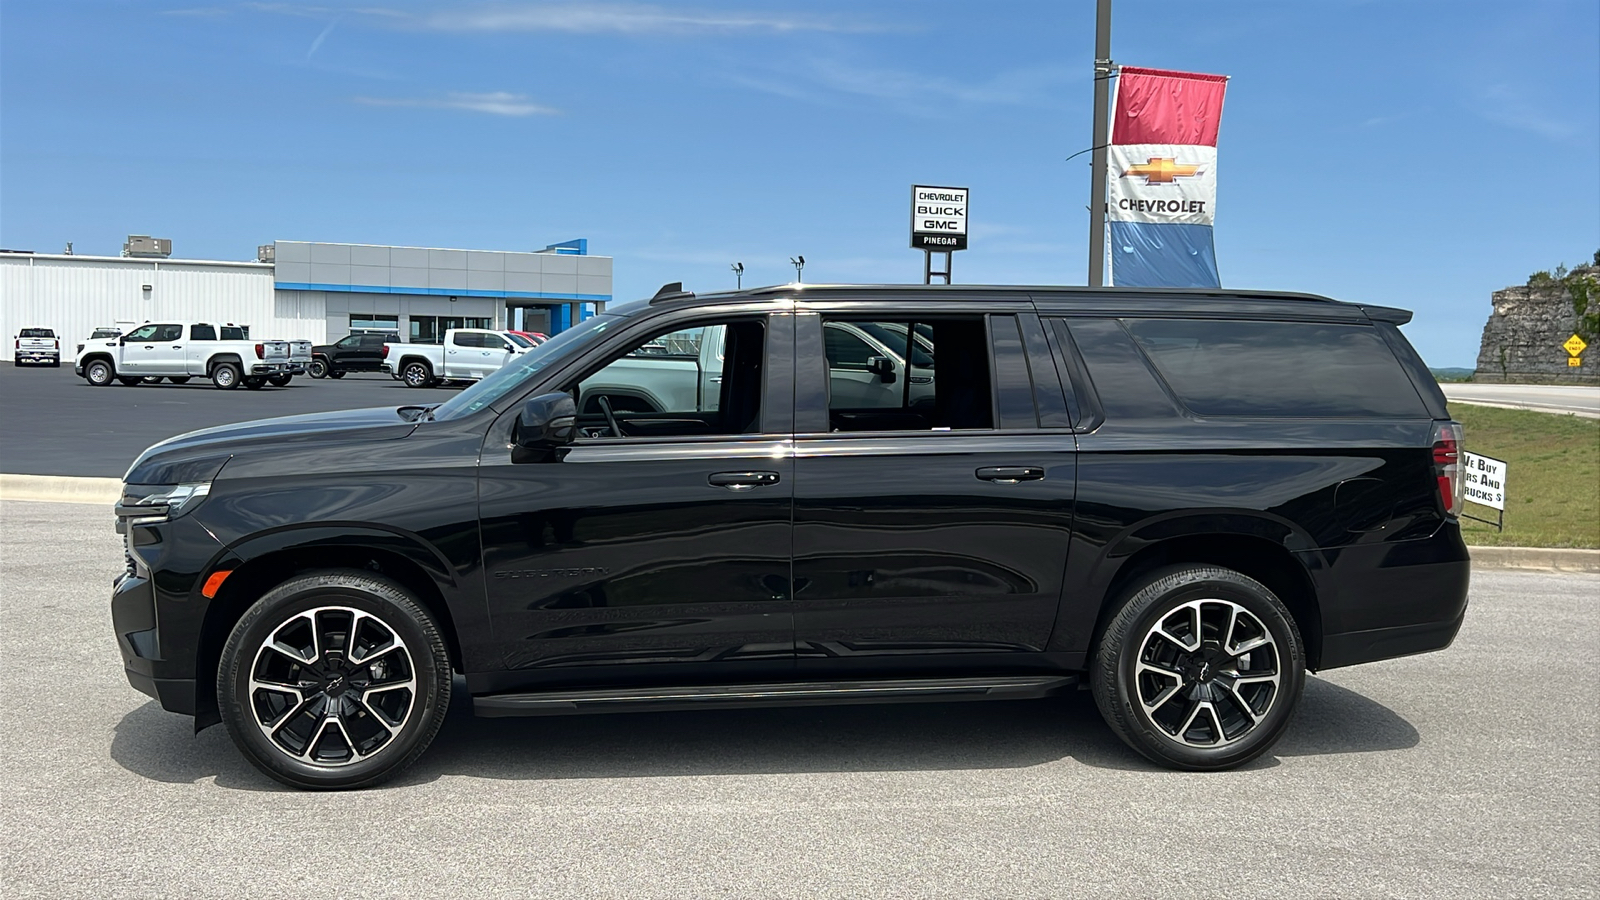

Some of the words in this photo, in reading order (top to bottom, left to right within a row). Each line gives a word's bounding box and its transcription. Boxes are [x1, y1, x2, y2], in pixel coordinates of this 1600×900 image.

[919, 192, 964, 202] CHEVROLET
[917, 206, 964, 216] BUICK
[924, 220, 957, 229] GMC
[923, 236, 957, 245] PINEGAR
[1464, 486, 1493, 501] RUCKS
